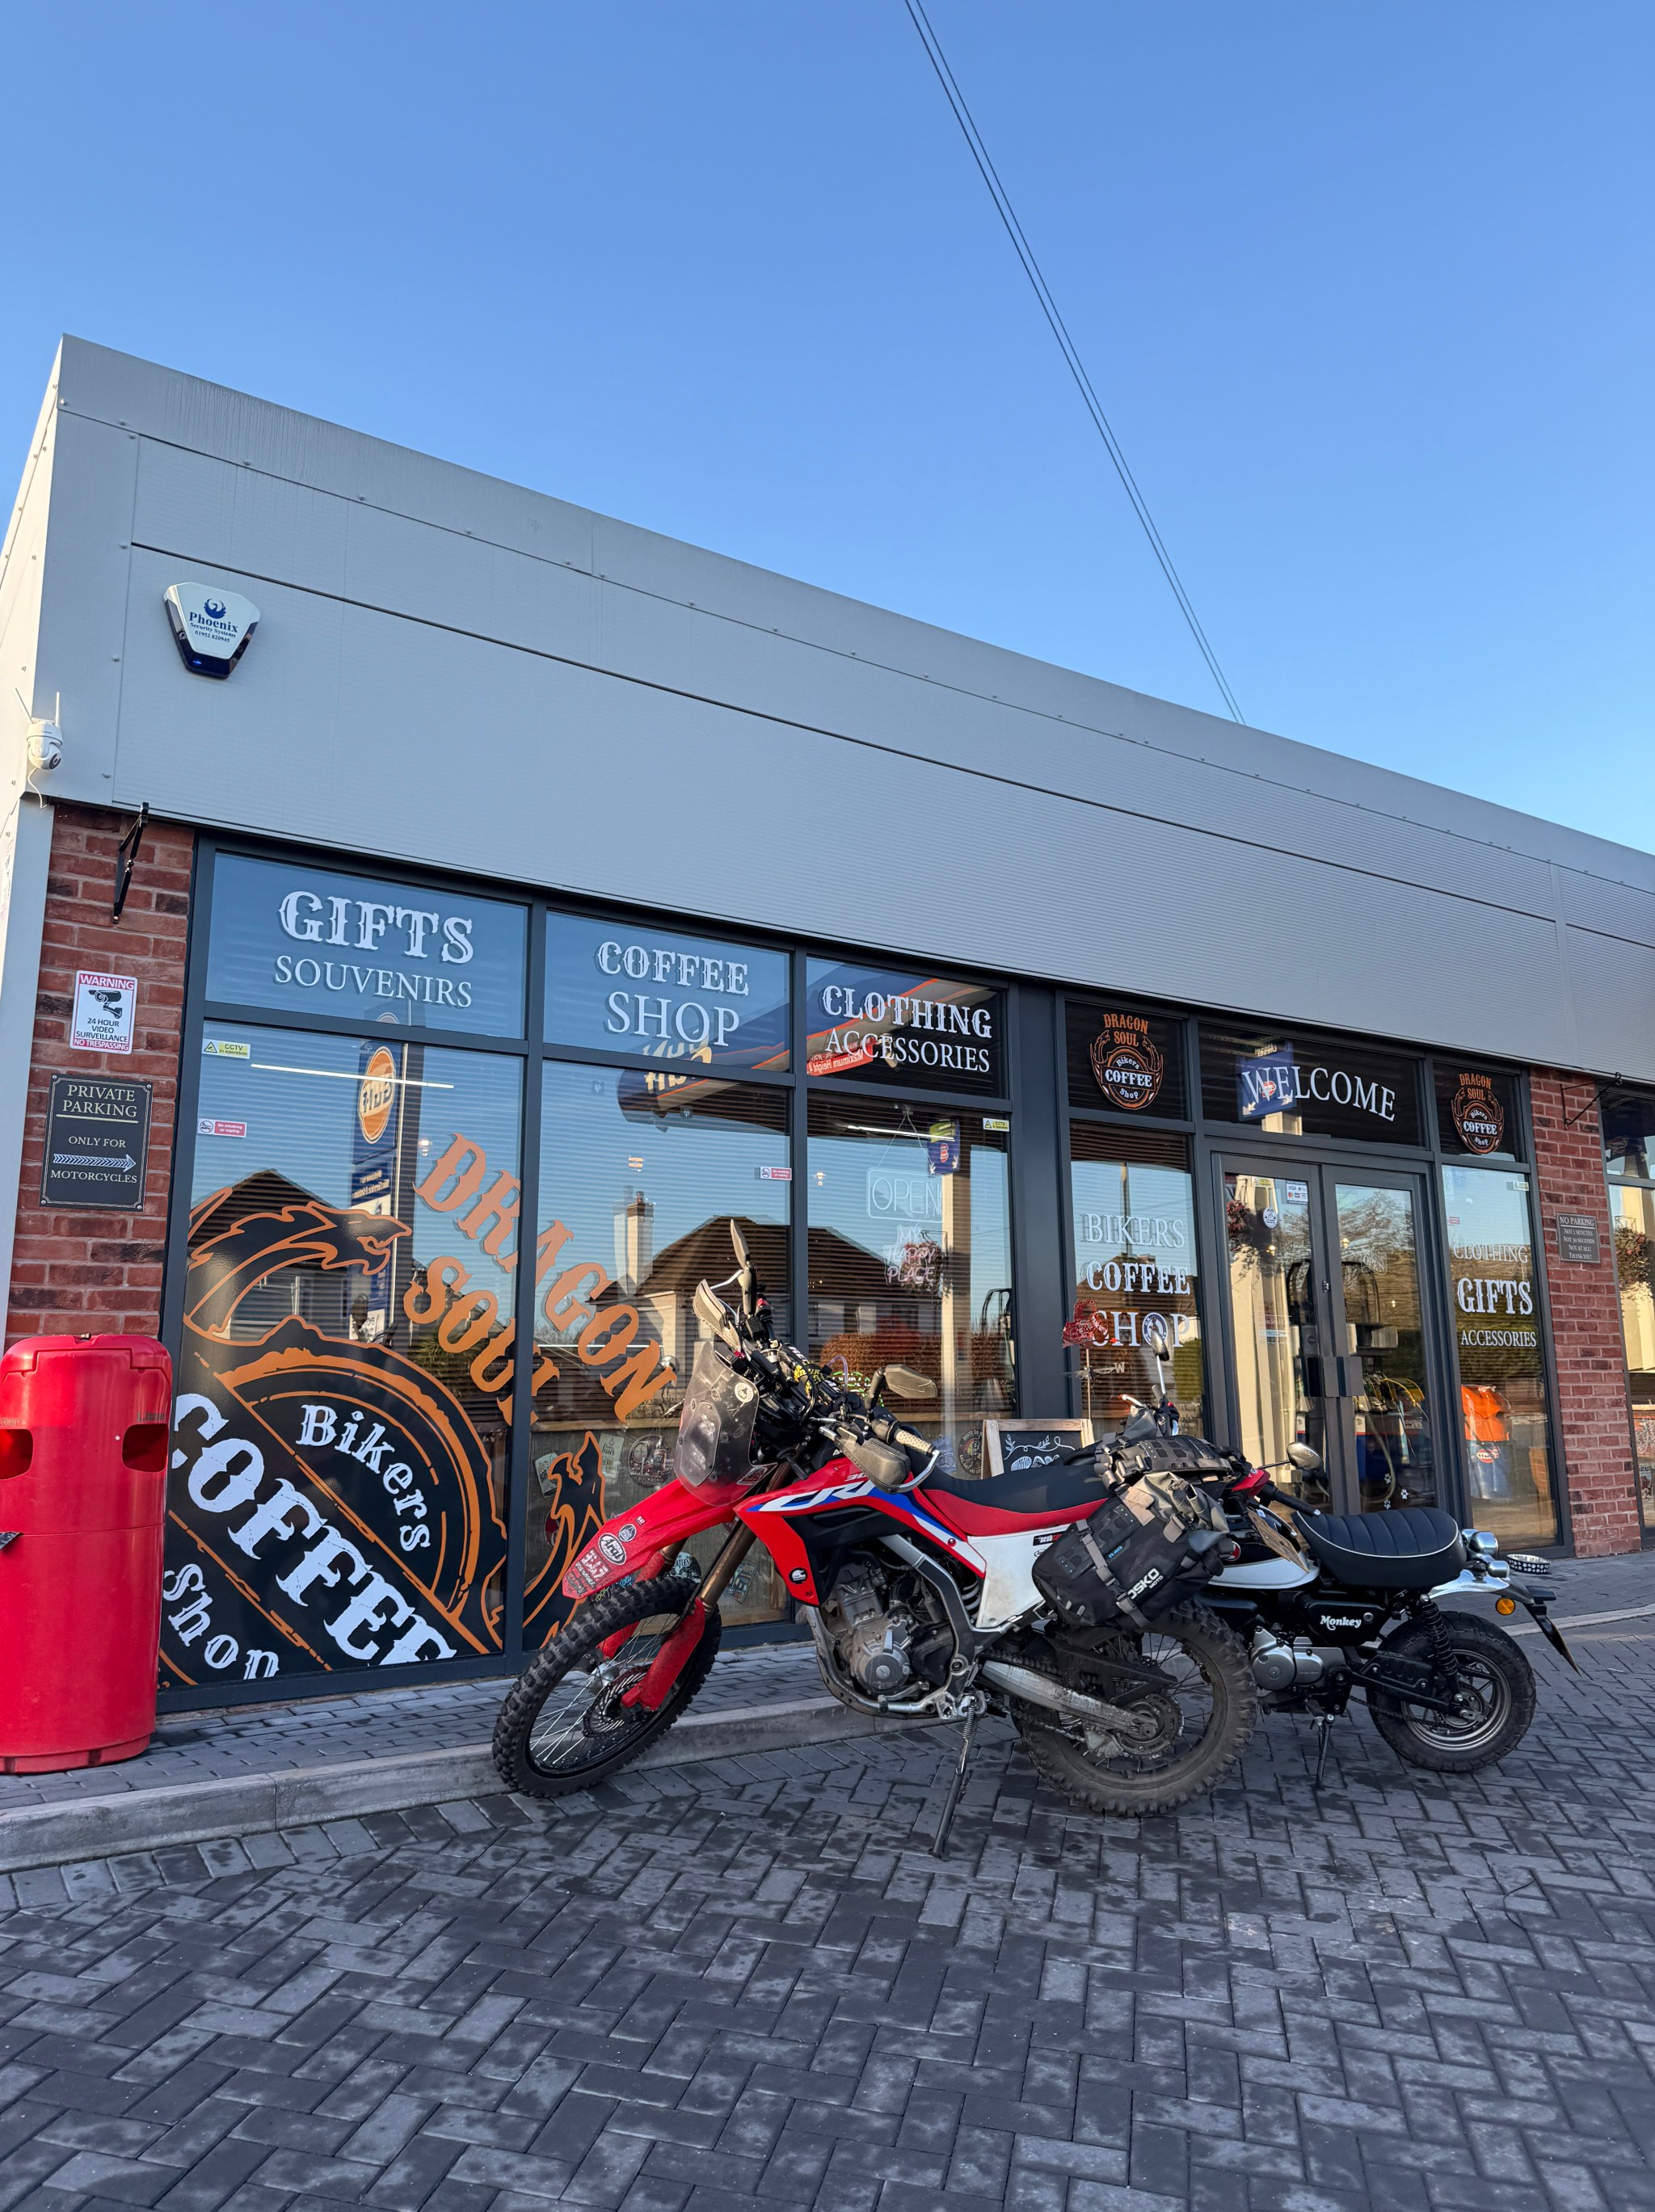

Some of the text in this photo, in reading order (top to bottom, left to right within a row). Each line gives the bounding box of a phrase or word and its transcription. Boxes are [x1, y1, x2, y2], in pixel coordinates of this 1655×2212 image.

[189, 611, 238, 633] Phoenix
[190, 622, 236, 637] Security Systems
[278, 891, 474, 964] GIFTS
[597, 941, 749, 996] COFFEE
[80, 974, 134, 990] WARNING
[275, 956, 472, 1007] SOUVENIRS
[607, 991, 740, 1047] SHOP
[822, 985, 992, 1038] CLOTHING
[91, 1025, 114, 1034] VIDEO
[1103, 1014, 1148, 1034] DRAGON
[76, 1031, 128, 1042] SURVEILLANCE
[86, 1040, 129, 1050] TRESPASSING
[1114, 1031, 1139, 1046] SOUL
[825, 1027, 990, 1073] ACCESSORIES
[1116, 1056, 1140, 1070] Bikers
[1105, 1069, 1152, 1087] COFFEE
[1459, 1073, 1492, 1090] DRAGON
[68, 1084, 136, 1102] PRIVATE
[1120, 1088, 1139, 1099] Shop
[1241, 1066, 1396, 1122] WELCOME
[1468, 1088, 1486, 1100] SOUL
[62, 1100, 138, 1118] PARKING
[1463, 1121, 1497, 1135] COFFEE
[68, 1136, 126, 1148] ONLY FOR
[50, 1170, 137, 1184] MOTORCYCLES
[873, 1177, 941, 1217] OPEN
[1085, 1213, 1185, 1248] BIKERS
[1570, 1217, 1594, 1226] PARKING
[898, 1224, 920, 1244] MY
[888, 1247, 937, 1264] HAPPY
[1454, 1243, 1528, 1264] CLOTHING
[412, 1133, 677, 1423] DRAGON
[887, 1266, 936, 1285] PLACE
[1086, 1260, 1191, 1295] COFFEE
[1458, 1277, 1533, 1315] GIFTS
[403, 1255, 560, 1426] SOUL
[1461, 1329, 1537, 1348] ACCESSORIES
[296, 1404, 432, 1551] Bikers
[600, 1537, 625, 1561] Arai
[1148, 1575, 1164, 1589] MOTO
[1320, 1615, 1362, 1631] Monkey
